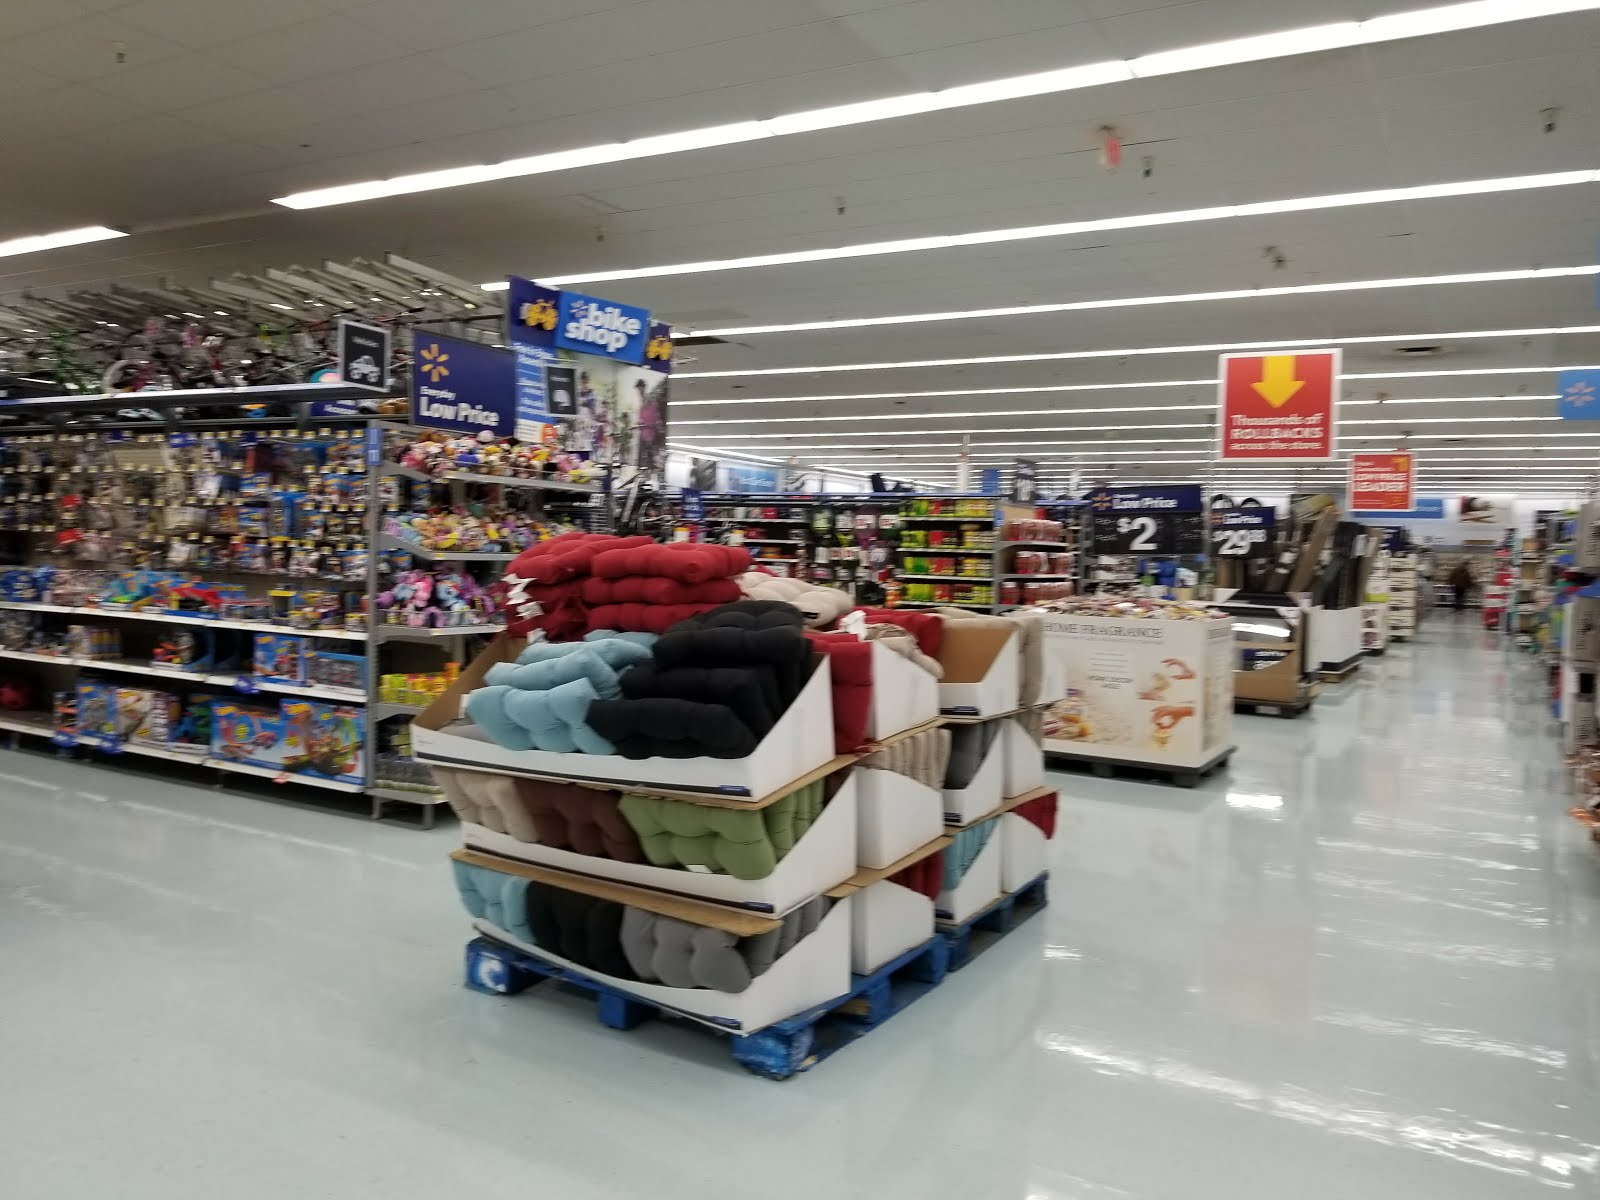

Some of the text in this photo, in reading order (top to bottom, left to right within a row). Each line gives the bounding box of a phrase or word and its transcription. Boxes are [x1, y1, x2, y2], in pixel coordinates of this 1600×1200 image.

[588, 303, 641, 335] bike
[565, 318, 628, 352] shop
[419, 397, 458, 420] Low
[457, 403, 499, 427] Price
[1230, 412, 1324, 426] Thousands of
[1230, 427, 1324, 439] ROLLBACKS
[1113, 497, 1178, 509] Low Price
[1116, 516, 1158, 550] $2
[1080, 624, 1164, 639] FRAGRANCE
